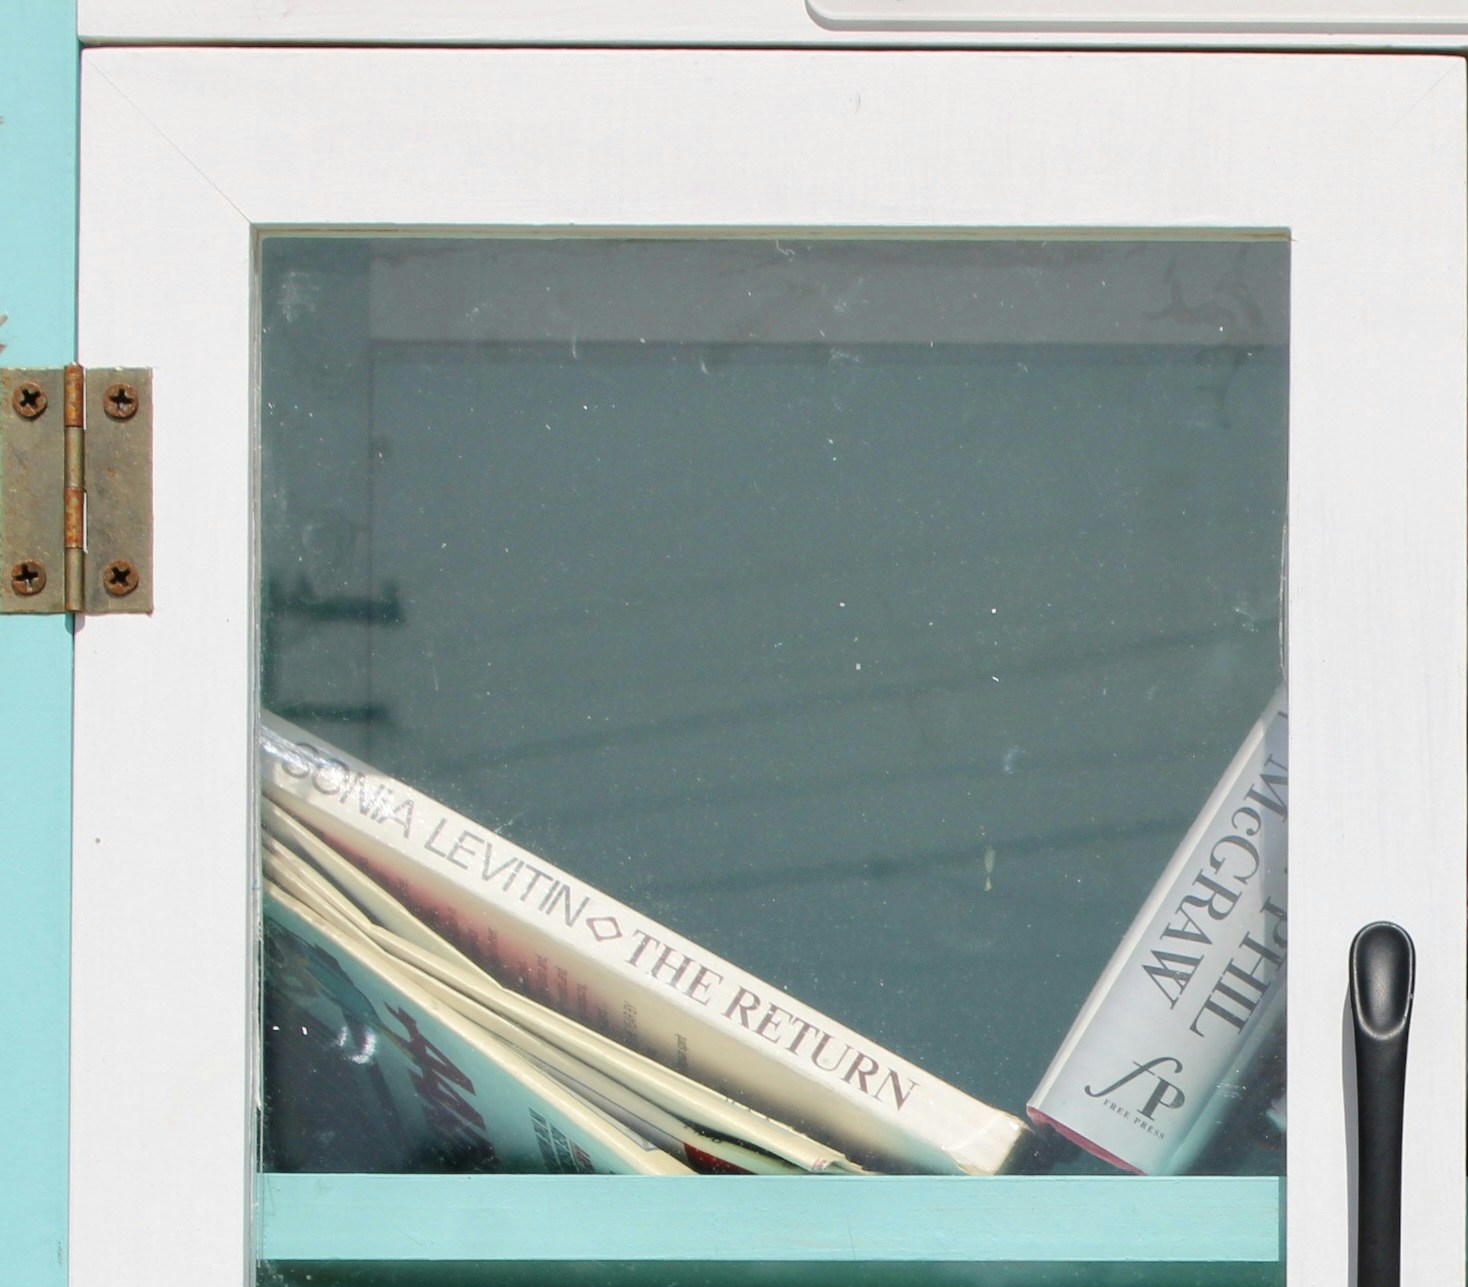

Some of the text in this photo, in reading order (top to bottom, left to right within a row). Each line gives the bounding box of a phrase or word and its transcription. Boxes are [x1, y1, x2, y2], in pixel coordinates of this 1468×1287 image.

[282, 742, 415, 838] SONIA
[424, 818, 590, 927] LEVITIN
[625, 929, 724, 1006] THE
[721, 985, 920, 1111] RETURN
[1141, 753, 1287, 1010] McGRAW
[1189, 896, 1287, 1038] PHIL
[1103, 1099, 1165, 1139] FREE PRESS
